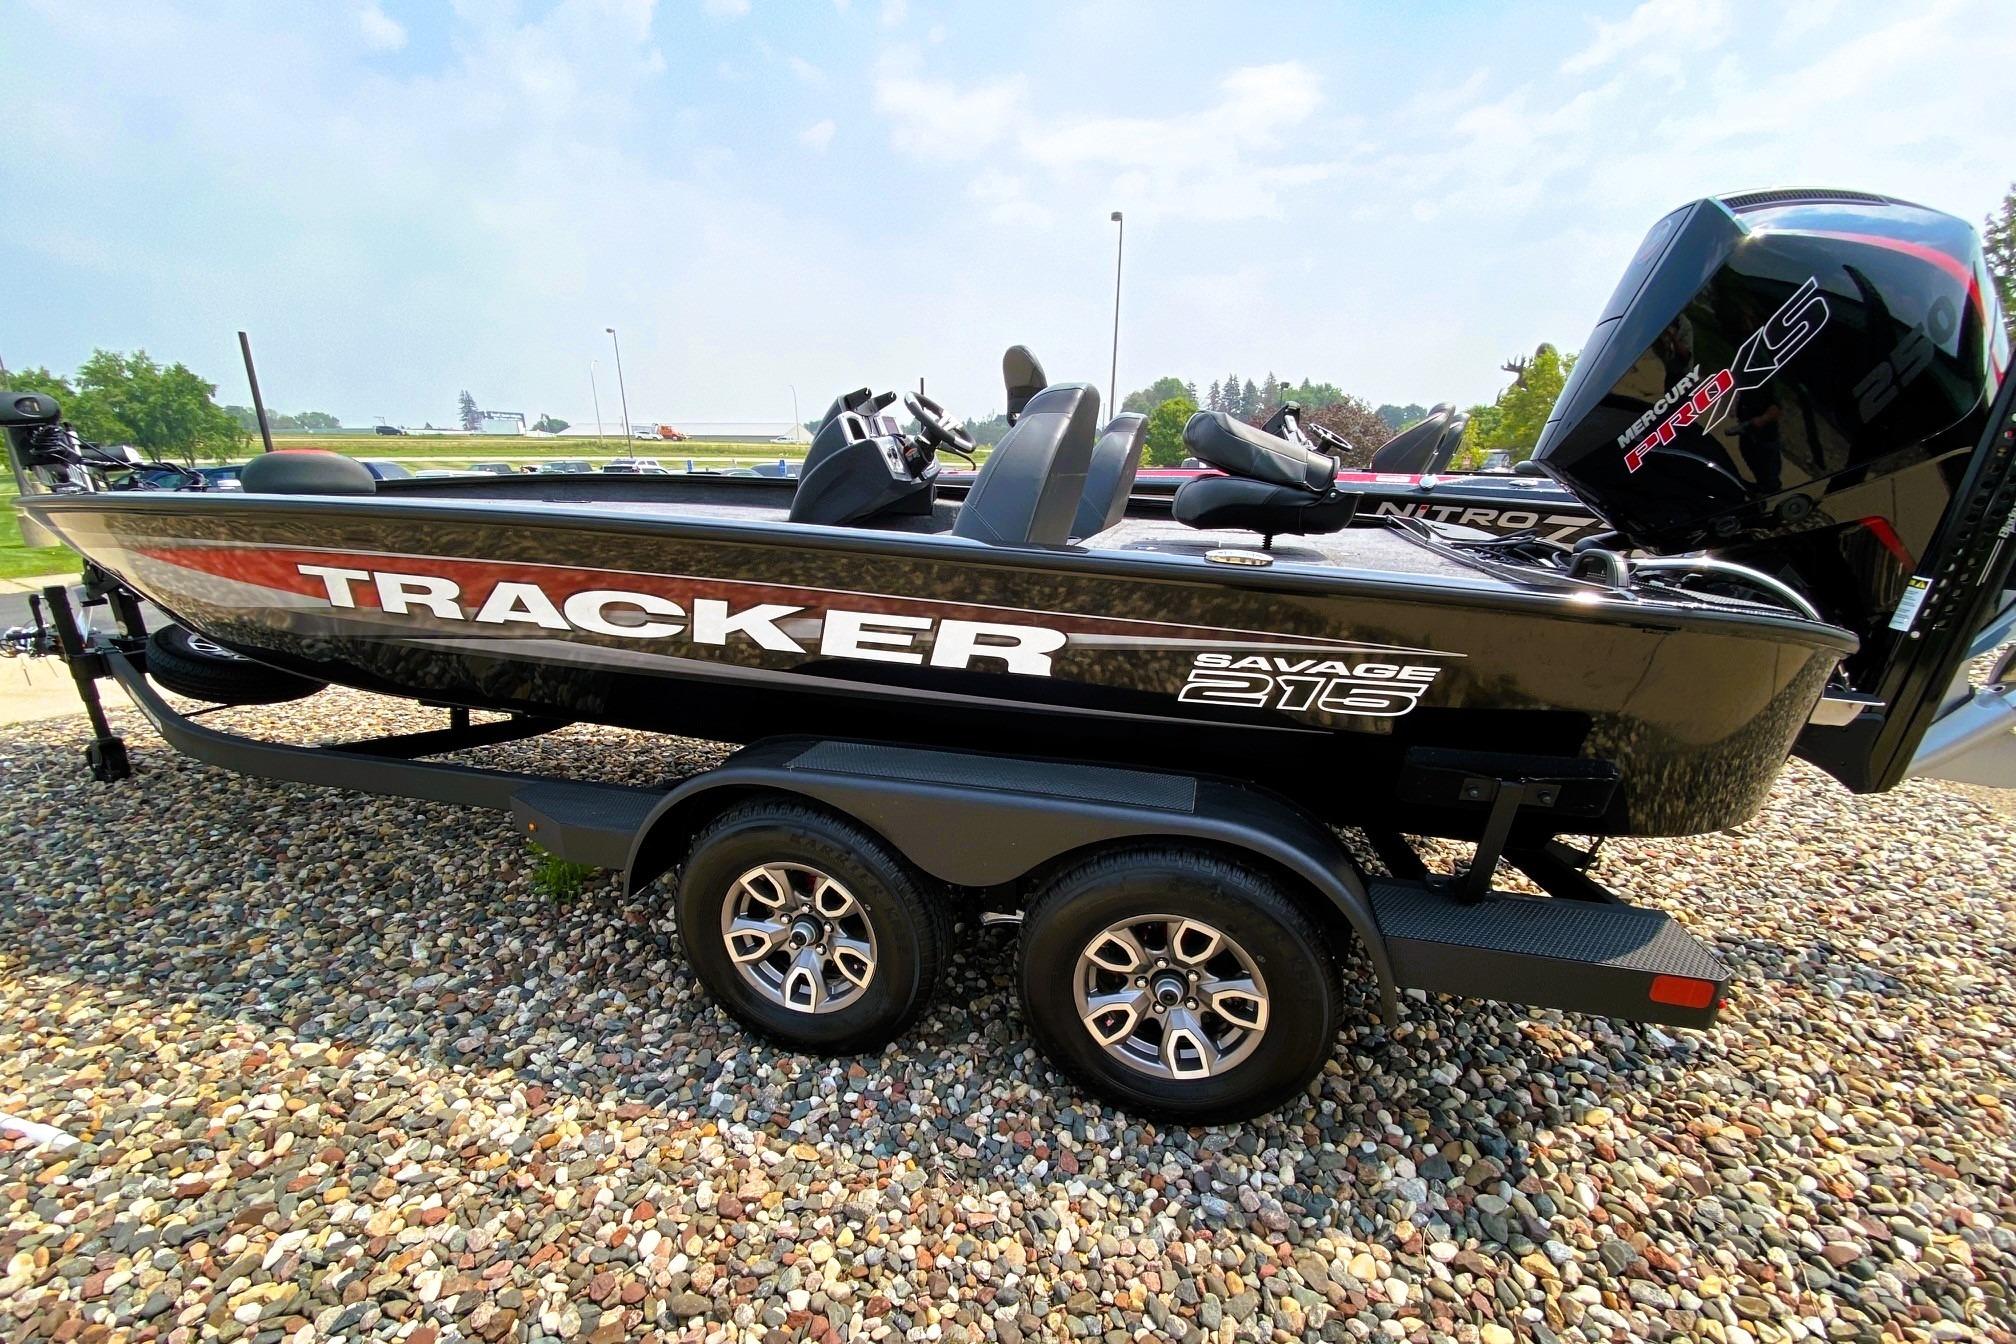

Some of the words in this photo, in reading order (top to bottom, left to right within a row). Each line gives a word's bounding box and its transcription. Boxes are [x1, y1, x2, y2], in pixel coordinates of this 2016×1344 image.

[1617, 364, 1701, 449] MERCURY
[1852, 296, 1957, 424] 250
[1624, 368, 1734, 473] PRO
[297, 564, 1068, 677] TRACKER
[1194, 653, 1442, 682] SAVAGE
[1177, 669, 1430, 717] 215
